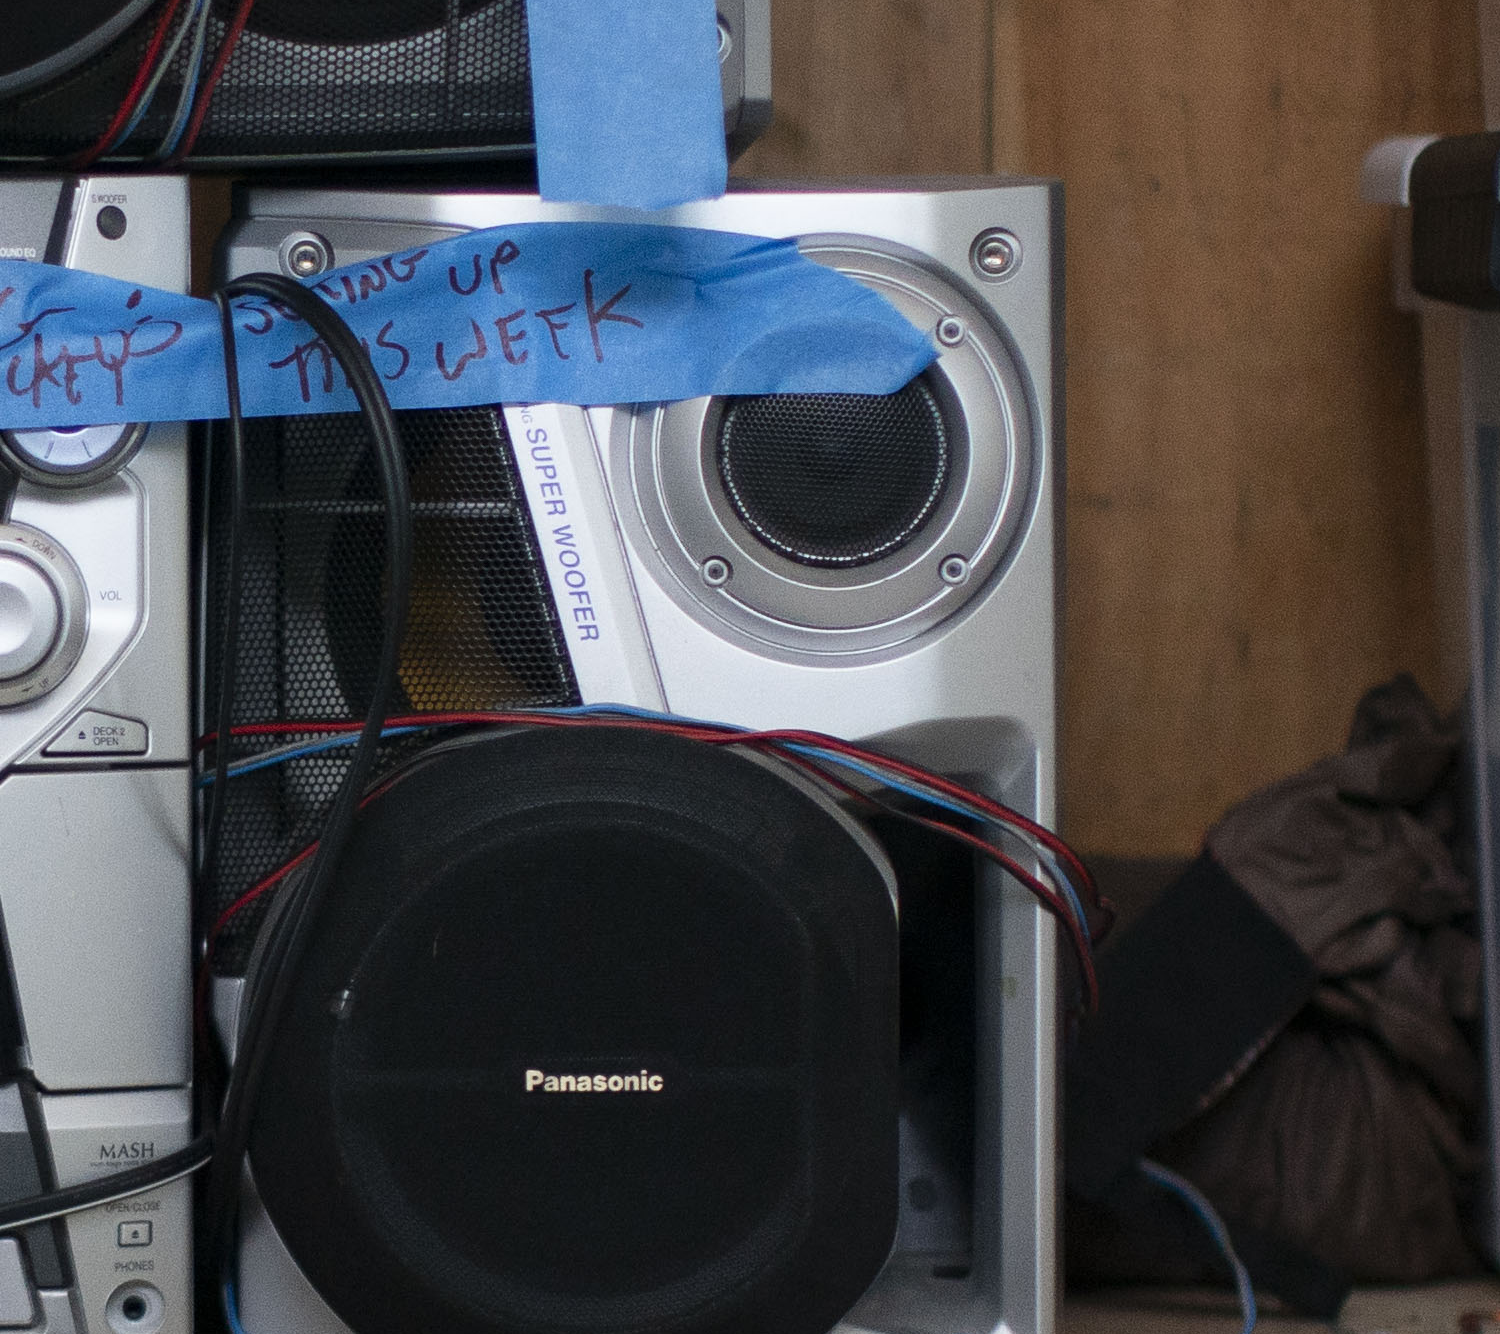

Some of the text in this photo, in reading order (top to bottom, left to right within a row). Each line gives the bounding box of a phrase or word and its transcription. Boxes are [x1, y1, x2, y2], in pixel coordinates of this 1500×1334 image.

[448, 239, 521, 296] UP
[435, 268, 644, 382] WEEK
[526, 428, 600, 642] SUPER WOOFER
[99, 590, 123, 601] VOL
[93, 726, 118, 736] DECK
[93, 736, 119, 746] OPEN
[525, 1069, 665, 1092] Panasonic
[99, 1141, 155, 1160] MASH
